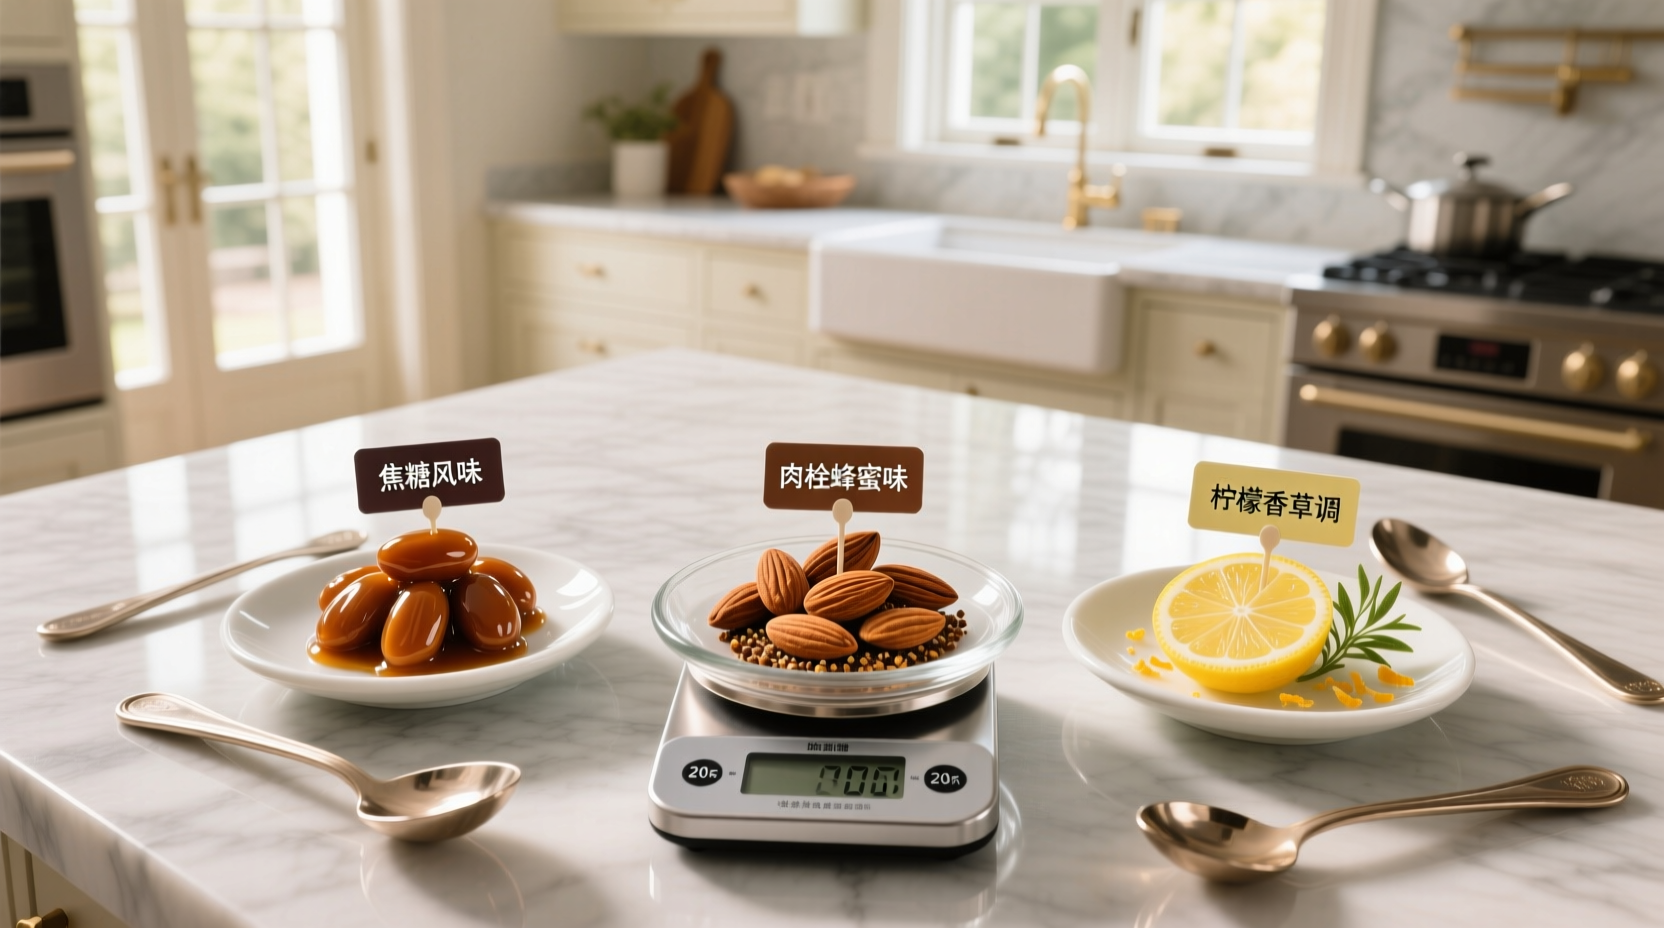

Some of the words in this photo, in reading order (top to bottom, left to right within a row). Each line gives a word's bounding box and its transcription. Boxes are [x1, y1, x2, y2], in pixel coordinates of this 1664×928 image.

[378, 457, 483, 493] 焦糖风味
[780, 462, 908, 493] 肉栓蜂蜜味
[1210, 483, 1341, 524] 柠檬香草调
